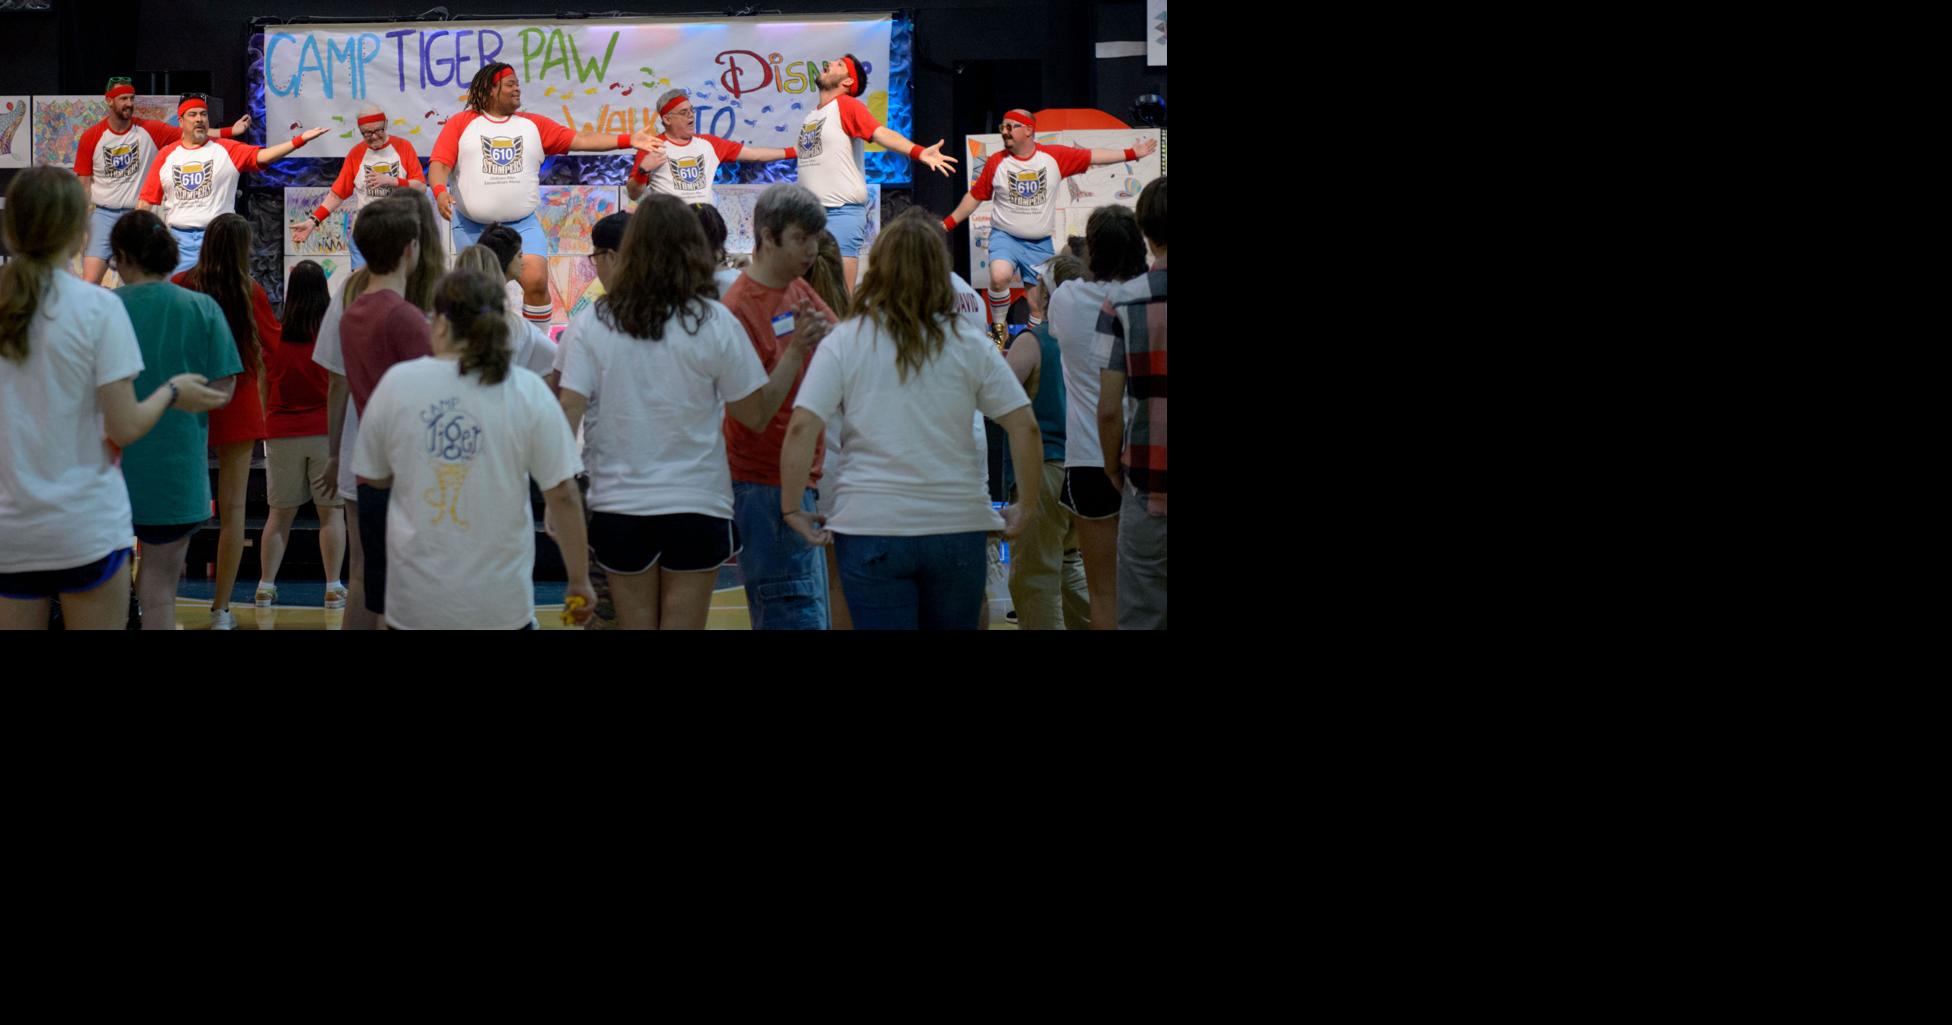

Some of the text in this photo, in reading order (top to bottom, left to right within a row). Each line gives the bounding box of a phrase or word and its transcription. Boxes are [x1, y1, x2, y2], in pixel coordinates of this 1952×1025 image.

[265, 27, 620, 100] CAMP TIGER PAW
[112, 154, 131, 167] 610
[492, 148, 514, 161] 610
[482, 158, 523, 175] STOMPERS
[680, 167, 698, 179] 610
[182, 172, 203, 186] 610
[1017, 181, 1038, 194] 610
